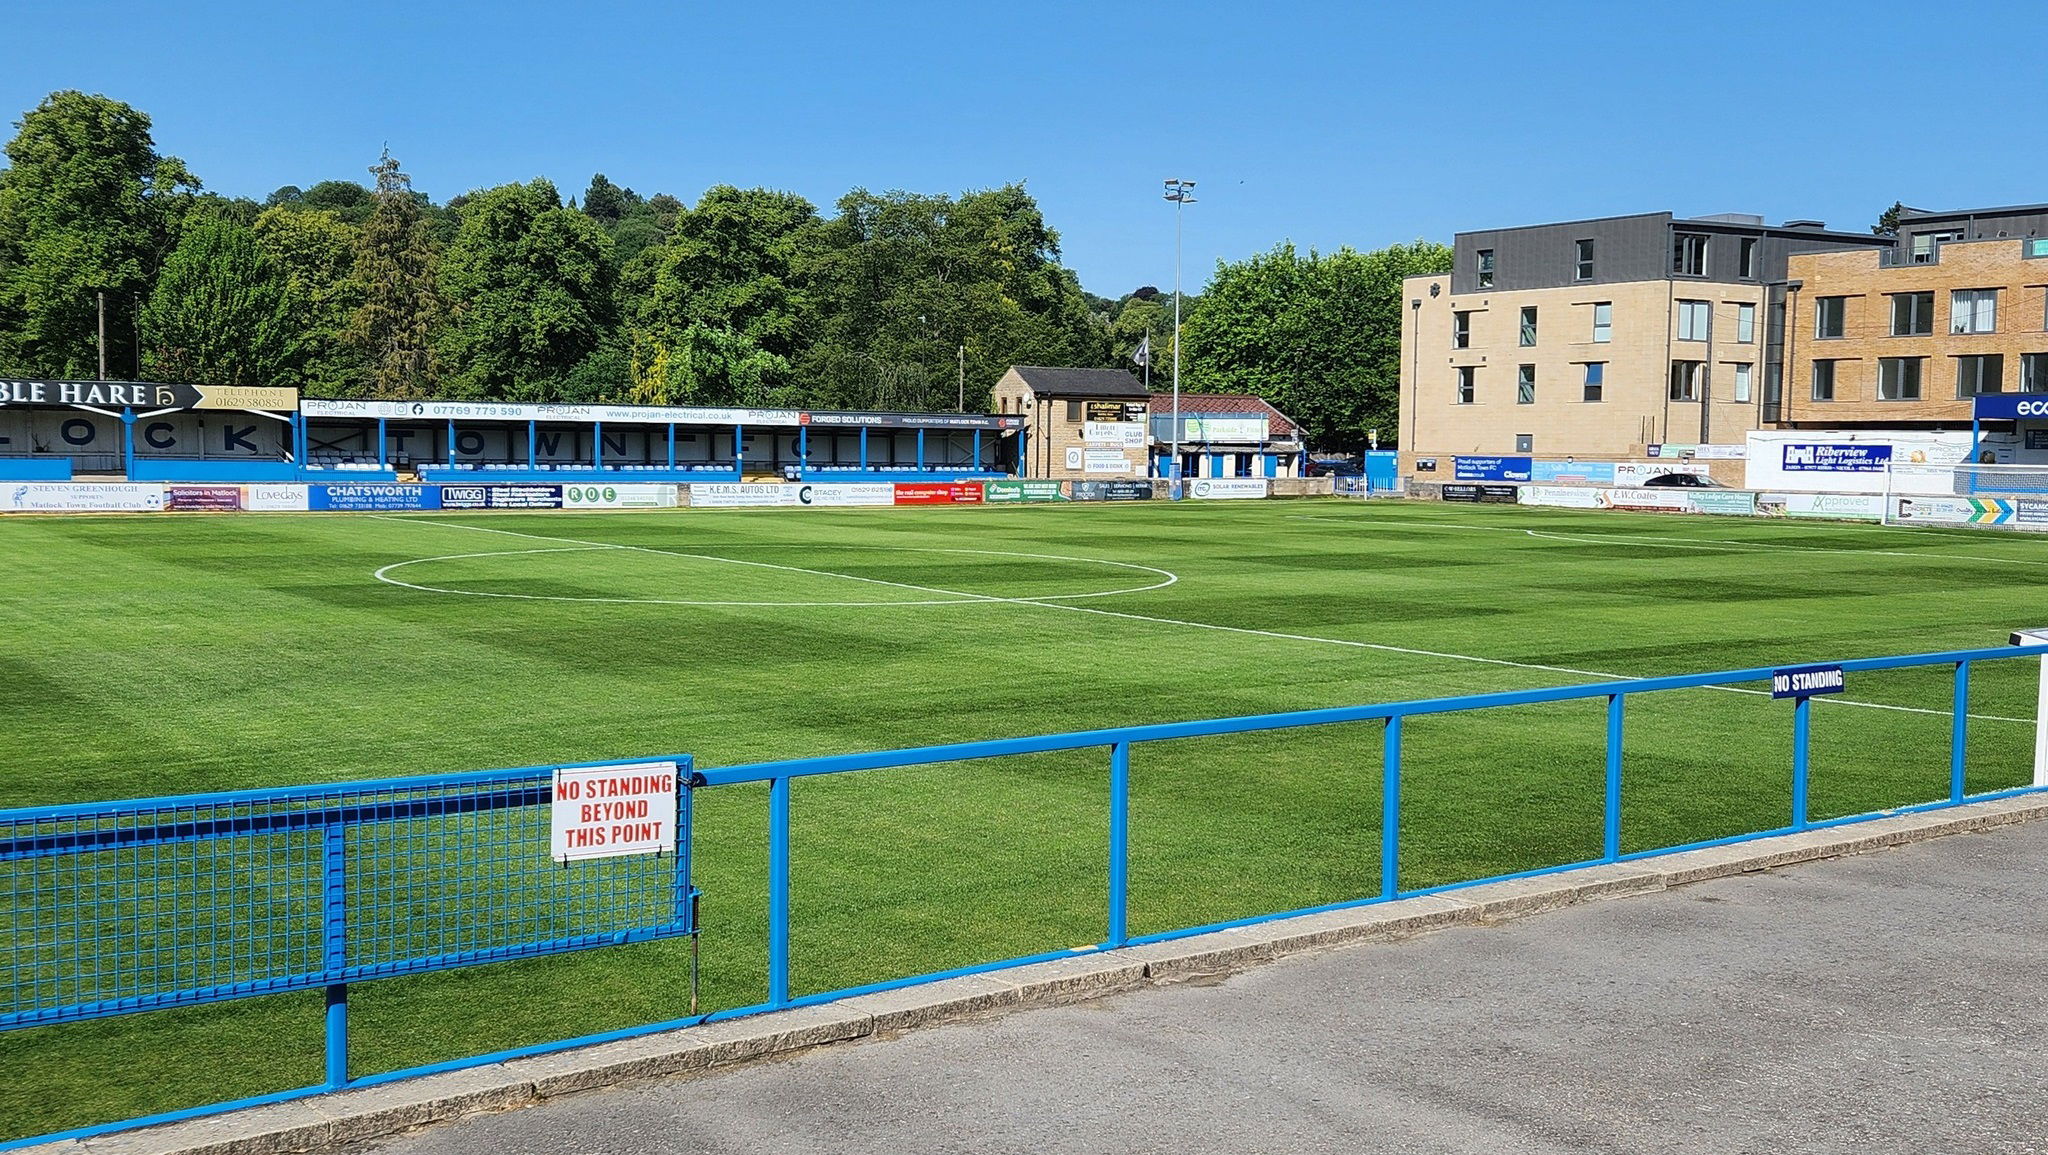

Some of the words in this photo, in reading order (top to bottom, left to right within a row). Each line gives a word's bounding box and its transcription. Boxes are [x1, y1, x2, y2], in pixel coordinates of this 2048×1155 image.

[58, 383, 146, 405] HARE
[216, 388, 284, 397] TELEPHONE
[215, 398, 245, 407] 01629
[247, 399, 284, 408] 580850
[307, 401, 366, 411] PROJAN
[433, 405, 471, 415] 07769
[475, 407, 497, 415] 779
[501, 408, 522, 416] 590
[537, 405, 591, 414] PROJAN
[748, 410, 797, 419] PROJAN
[605, 410, 732, 422] www.projan-electrical.co.uk
[811, 415, 841, 423] FORGED
[842, 415, 882, 424] SOLUTIONS
[1816, 446, 1868, 457] Riberview
[1816, 456, 1836, 465] Light
[1837, 457, 1873, 466] Logistics
[1618, 465, 1674, 476] PROJAN
[256, 486, 303, 504] Lovedays
[326, 486, 422, 496] CHATSWORTH
[448, 488, 483, 500] TWIGG
[709, 485, 739, 495] K.E.M.S.
[740, 486, 765, 494] AUTOS
[766, 486, 780, 494] LTD
[89, 501, 120, 509] Football
[123, 501, 142, 509] Club
[1774, 674, 1790, 693] NO
[1791, 669, 1843, 691] STANDING
[556, 781, 580, 801] NO
[585, 774, 673, 799] STANDING
[581, 800, 648, 823] BEYOND
[565, 826, 606, 848] THIS
[611, 822, 663, 845] POINT
